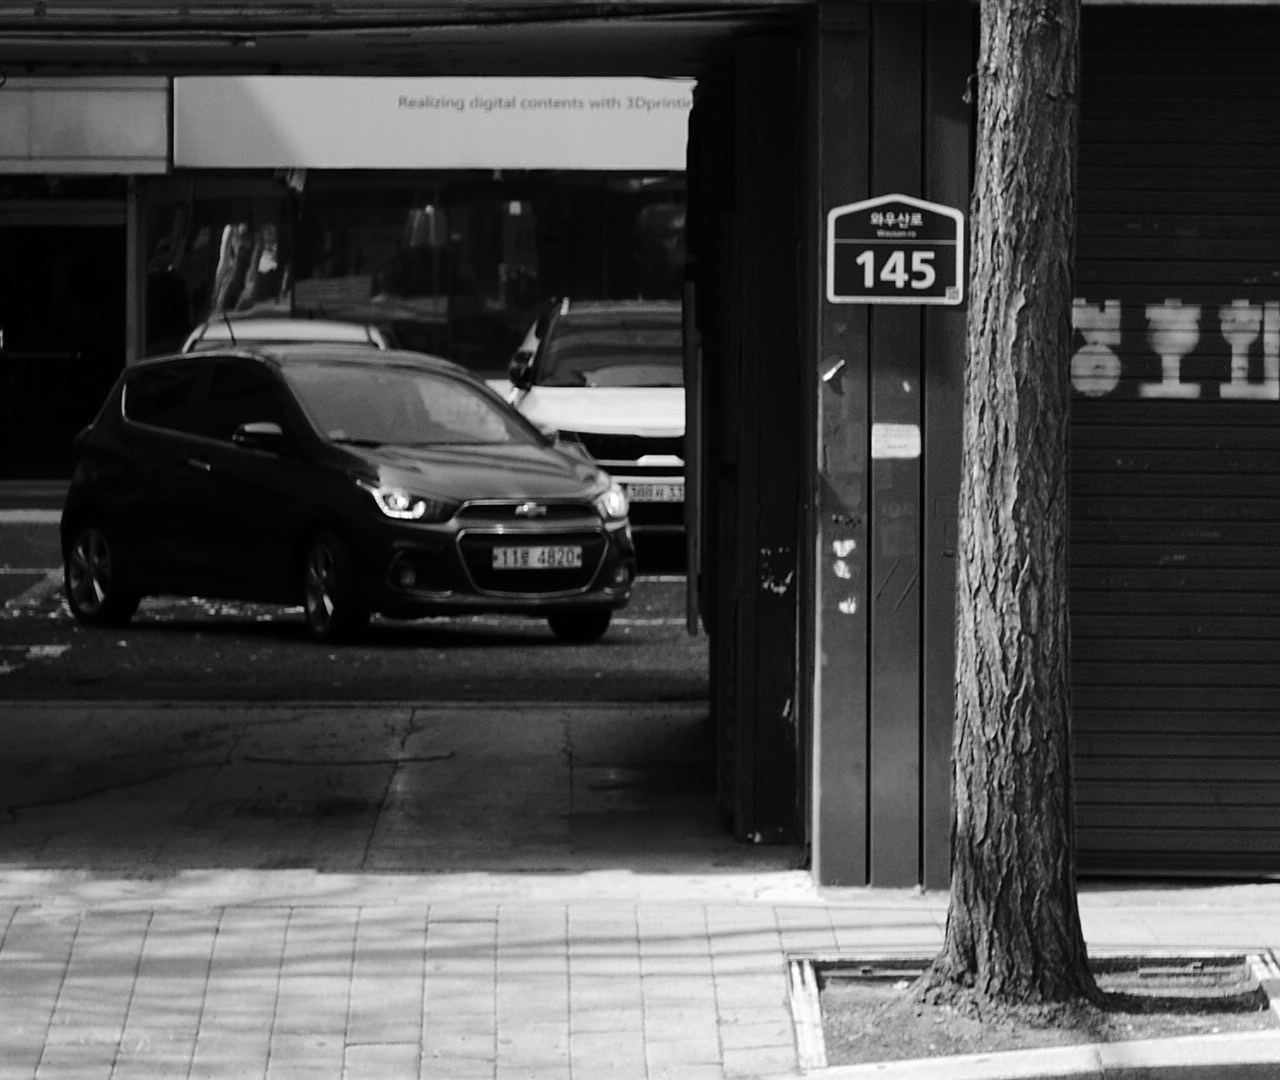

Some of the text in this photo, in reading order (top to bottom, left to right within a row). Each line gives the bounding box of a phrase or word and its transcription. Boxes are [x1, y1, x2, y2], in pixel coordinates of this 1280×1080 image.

[398, 94, 465, 112] Realizing
[469, 94, 516, 112] digital
[520, 96, 584, 110] contents
[588, 94, 622, 110] with
[870, 211, 924, 229] 와우산로
[855, 250, 936, 289] 145
